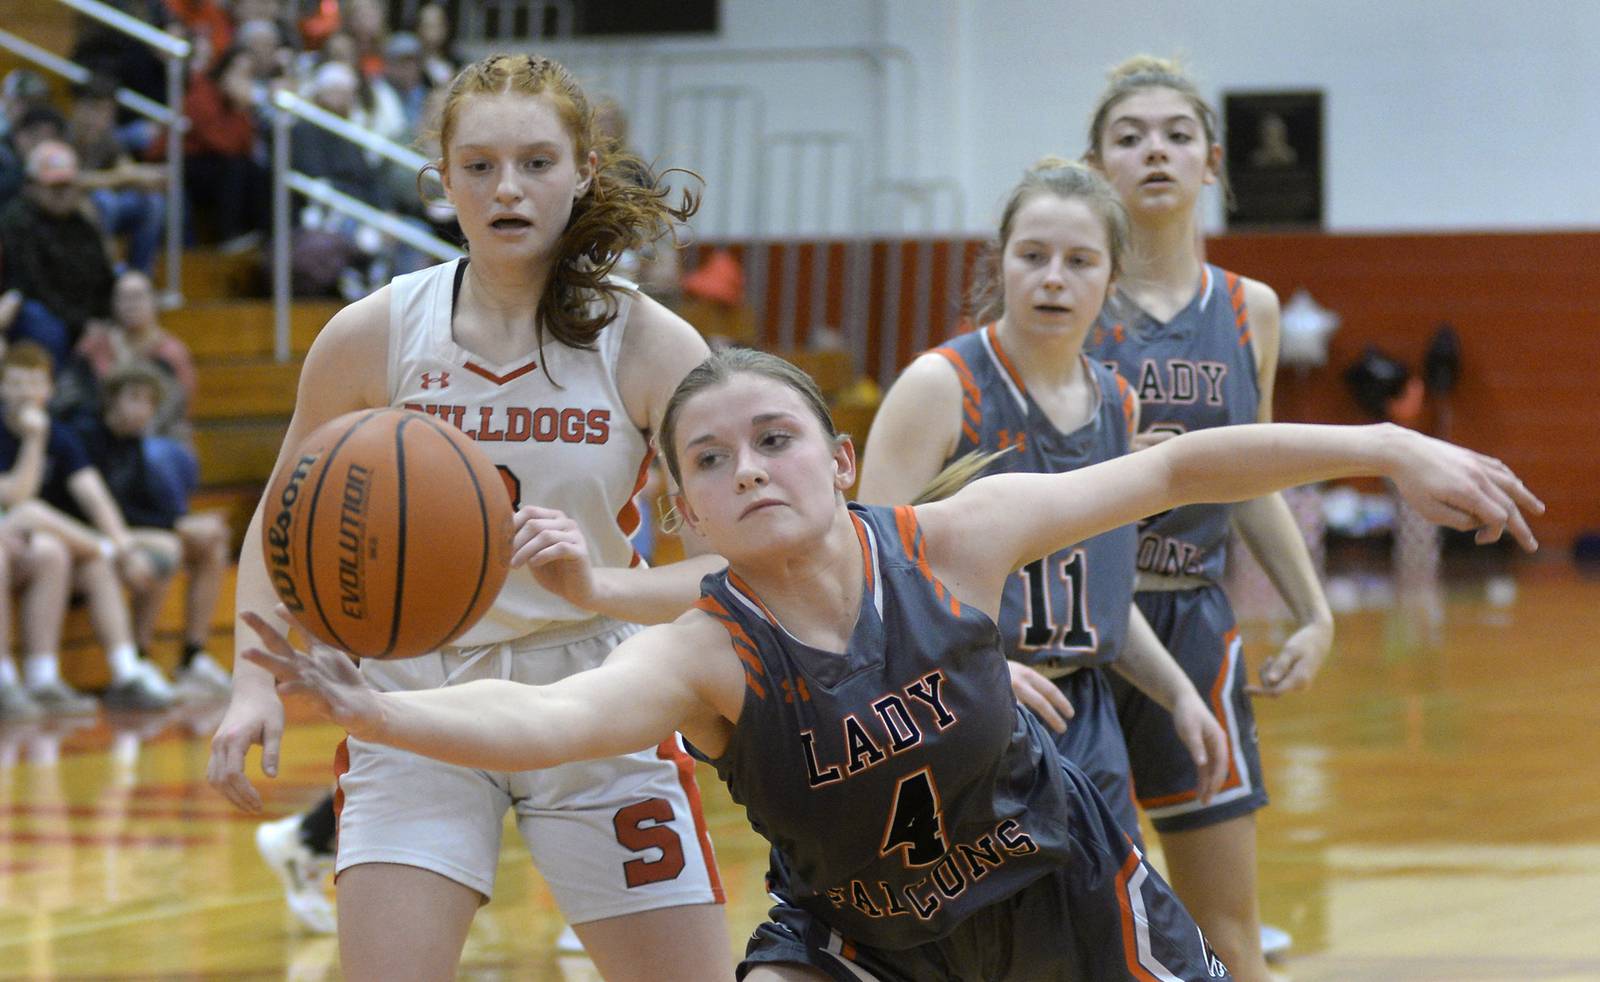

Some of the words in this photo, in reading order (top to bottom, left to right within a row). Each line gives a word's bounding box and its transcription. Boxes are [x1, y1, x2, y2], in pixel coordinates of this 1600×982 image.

[1104, 358, 1228, 406] ADY
[269, 455, 318, 613] Wilson
[338, 464, 369, 620] EVOLUTION
[1018, 548, 1098, 653] 11
[799, 667, 957, 789] LADY
[612, 797, 686, 889] S
[879, 766, 951, 868] 4
